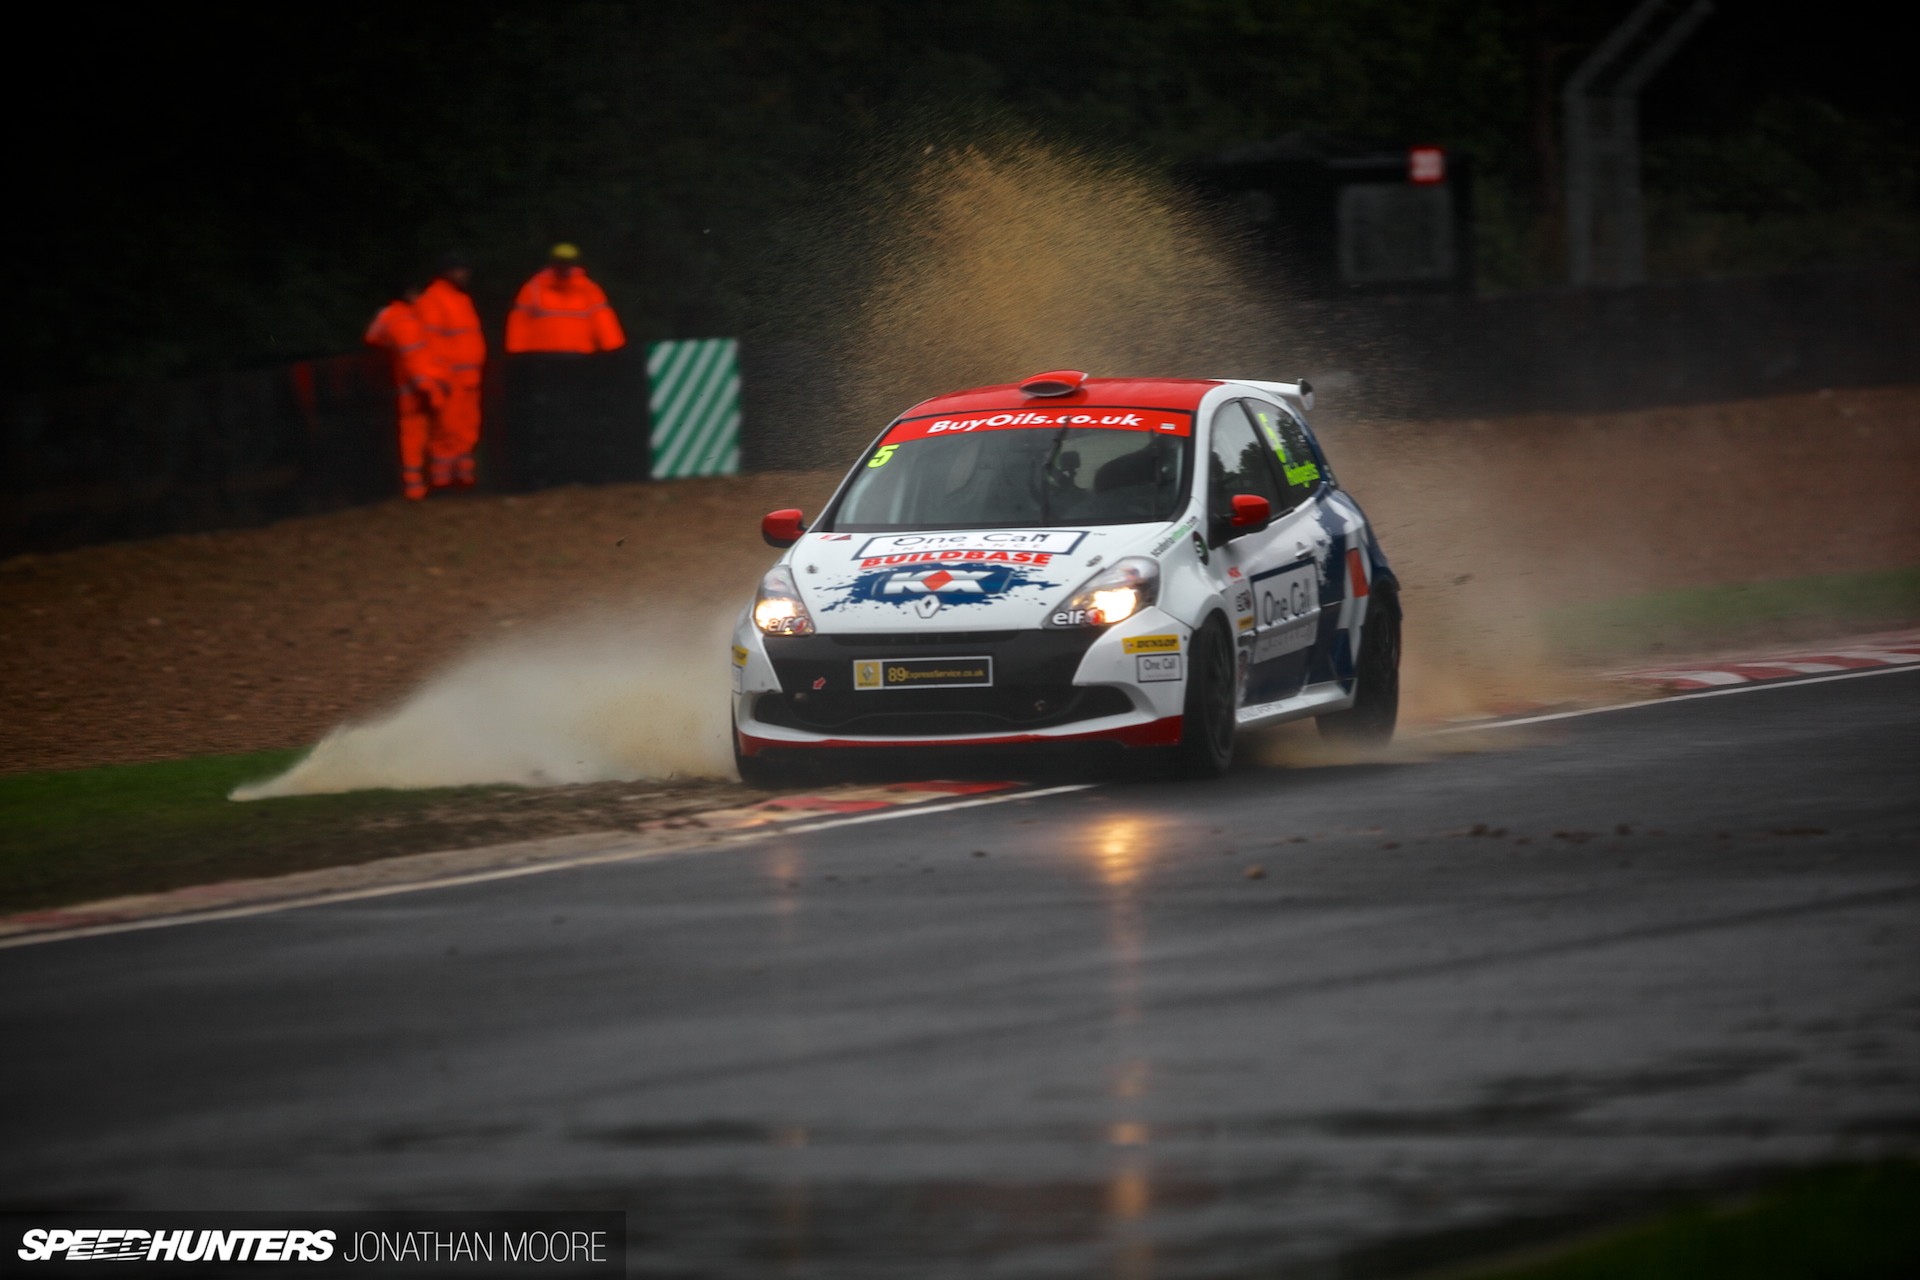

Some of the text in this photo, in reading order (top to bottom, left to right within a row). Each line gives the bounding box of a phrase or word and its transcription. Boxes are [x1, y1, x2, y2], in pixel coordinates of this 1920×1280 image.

[927, 412, 1144, 434] BuyOils.co.uk
[867, 444, 900, 468] 5
[892, 536, 937, 546] One
[859, 551, 1053, 569] BUILDBASE
[1263, 591, 1288, 627] One
[1290, 578, 1312, 617] Call
[768, 616, 794, 632] elf
[1052, 609, 1085, 625] elf
[1143, 658, 1176, 671] One Call
